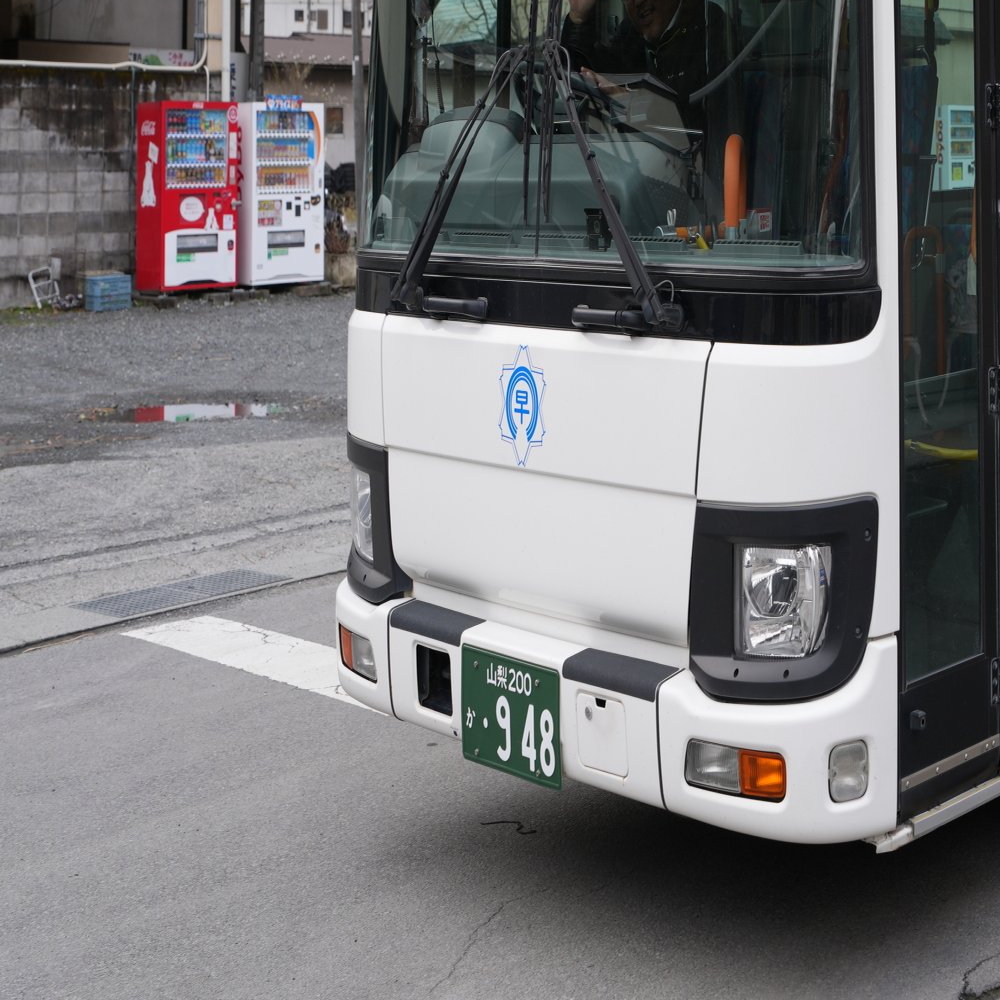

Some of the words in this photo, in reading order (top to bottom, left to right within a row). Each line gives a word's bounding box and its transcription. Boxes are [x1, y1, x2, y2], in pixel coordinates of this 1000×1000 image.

[514, 389, 530, 425] 早
[486, 662, 532, 697] 山梨200
[466, 706, 476, 729] か
